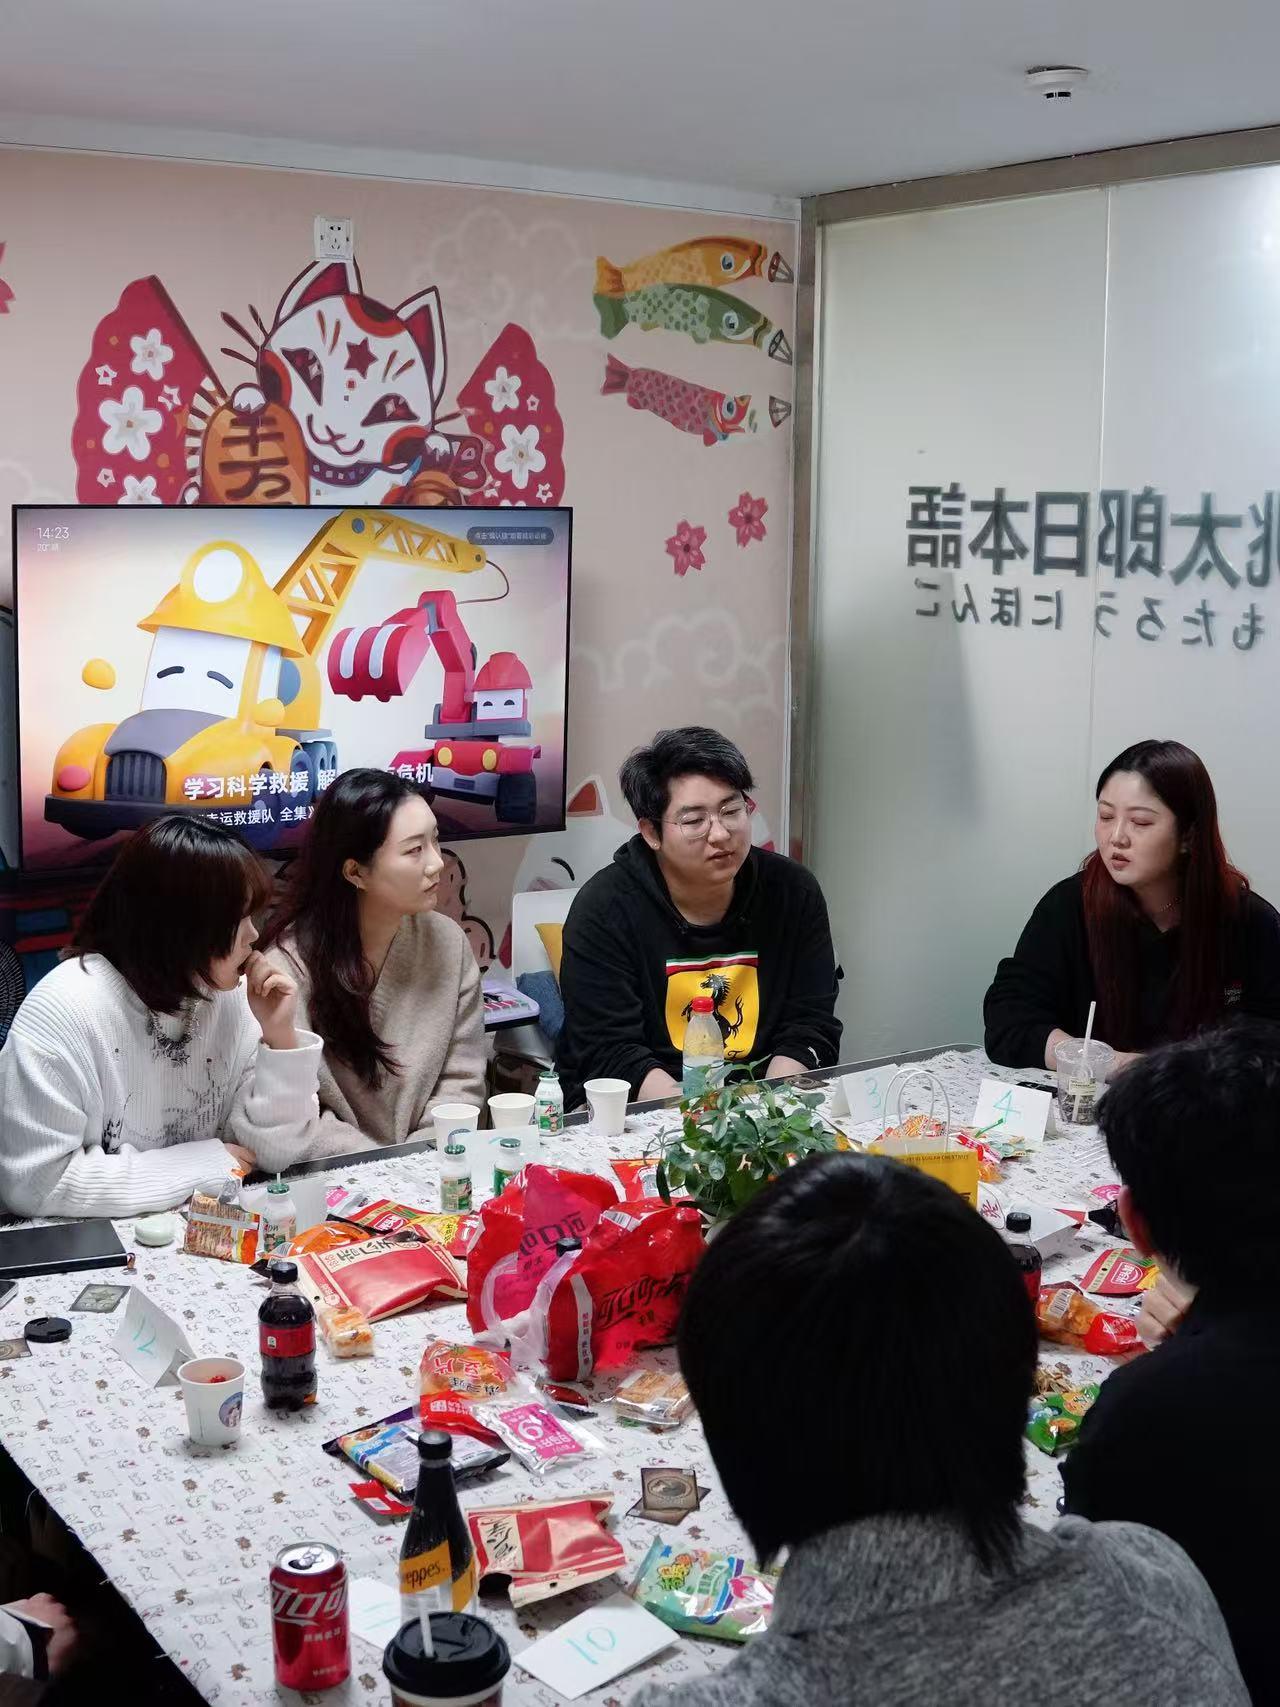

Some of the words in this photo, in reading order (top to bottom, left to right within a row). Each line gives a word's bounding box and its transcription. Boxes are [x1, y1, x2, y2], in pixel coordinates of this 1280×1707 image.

[36, 526, 70, 539] 14:23
[183, 770, 310, 800] 学习科学救援
[864, 1077, 882, 1109] 3
[993, 1090, 1022, 1123] 4
[402, 1562, 441, 1589] eppes
[564, 1627, 617, 1665] 10
